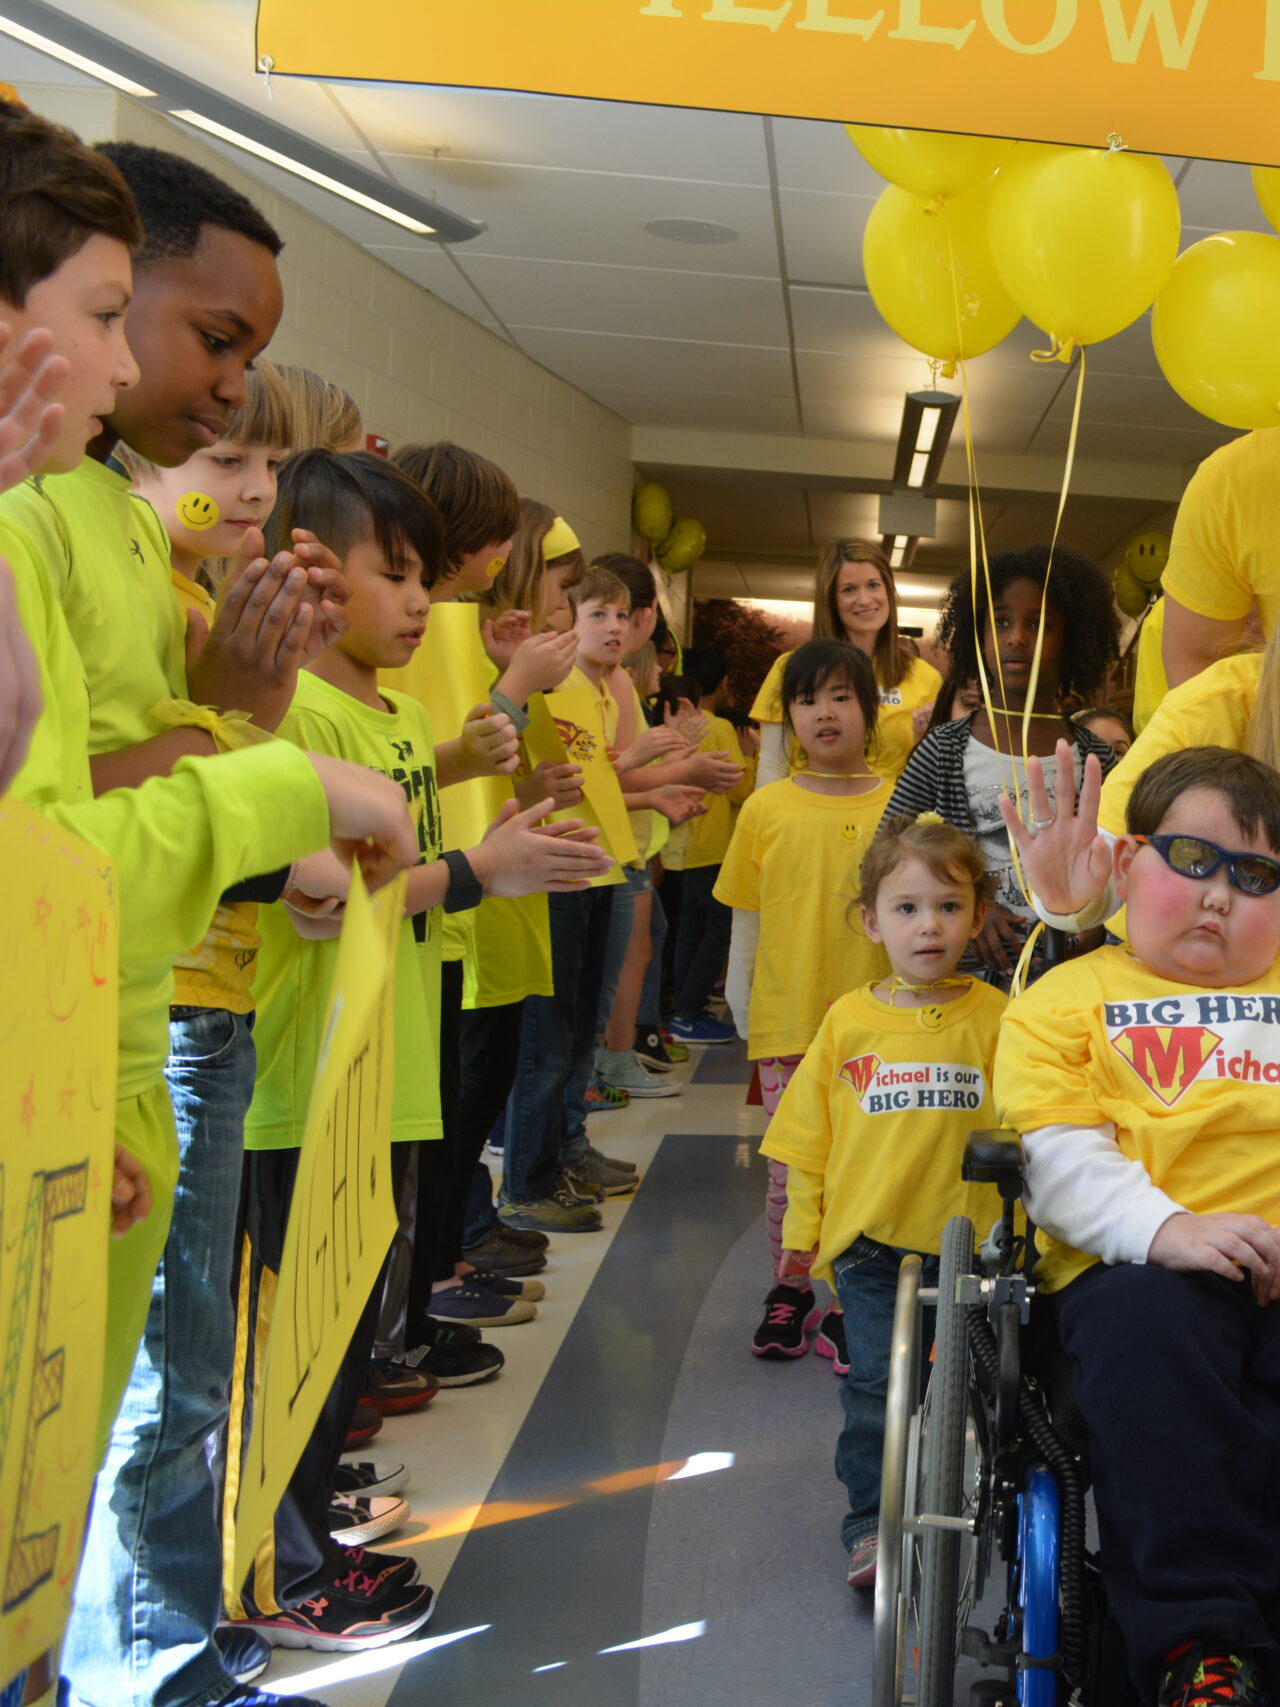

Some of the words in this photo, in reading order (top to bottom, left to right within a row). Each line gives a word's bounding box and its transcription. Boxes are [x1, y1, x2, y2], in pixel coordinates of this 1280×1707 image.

[1104, 1001, 1185, 1027] BIG
[844, 1054, 930, 1092] Michael
[936, 1067, 949, 1083] is
[954, 1072, 979, 1084] our
[868, 1091, 910, 1113] BIG
[917, 1090, 979, 1109] HERO
[260, 950, 391, 1488] IGHT!
